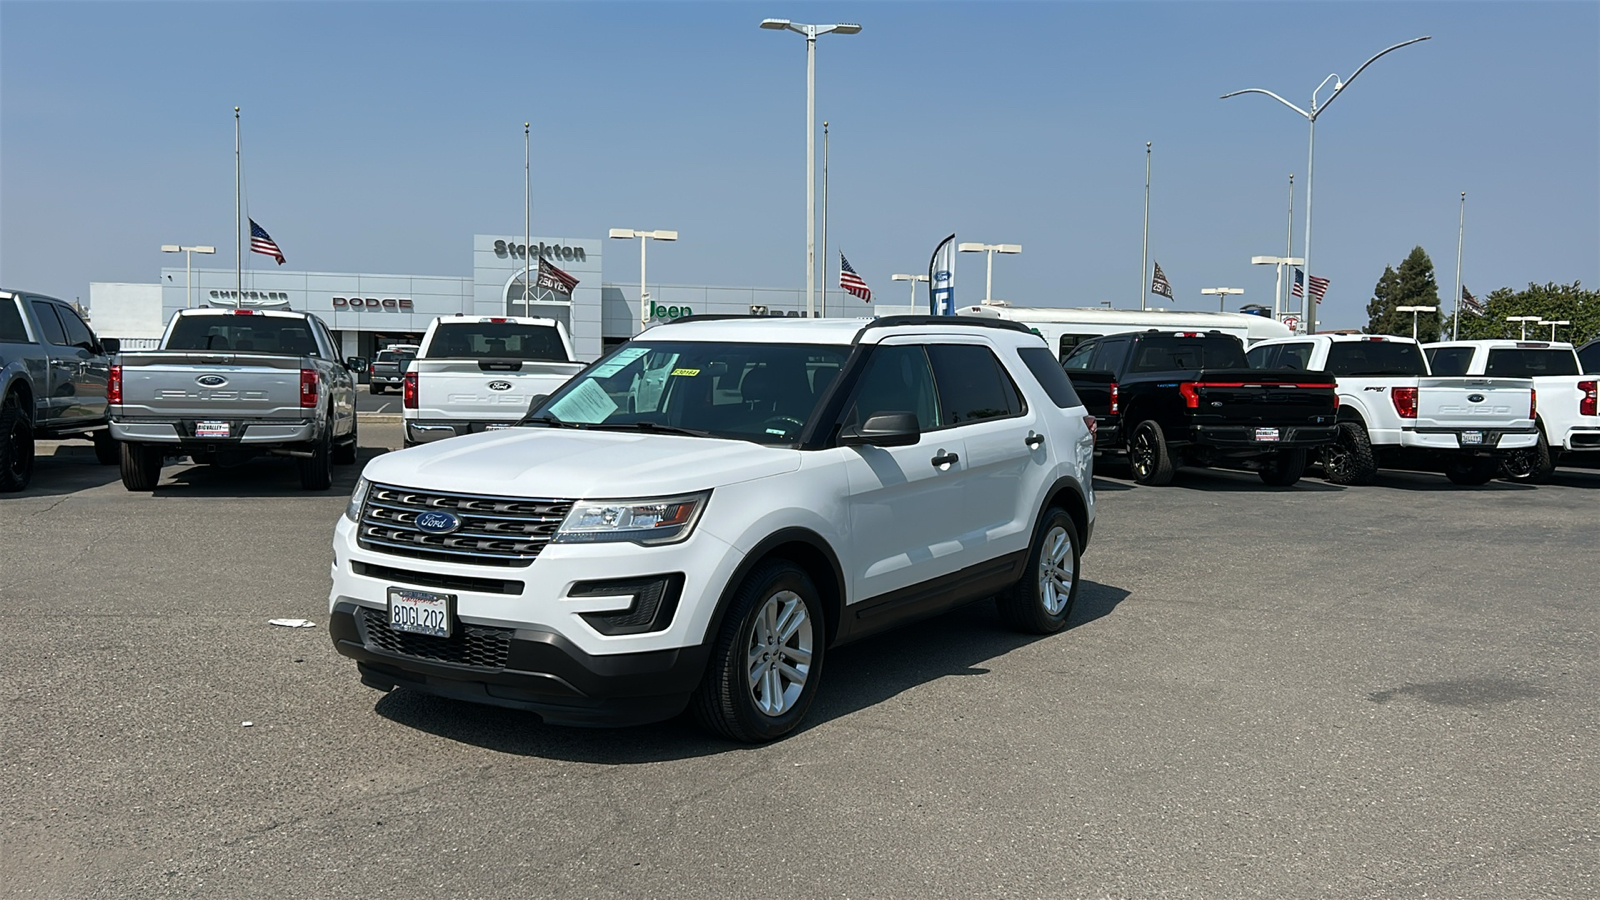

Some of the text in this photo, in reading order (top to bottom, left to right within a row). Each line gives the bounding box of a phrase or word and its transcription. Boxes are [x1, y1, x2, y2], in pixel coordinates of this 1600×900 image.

[494, 240, 586, 261] Stockton
[209, 290, 289, 300] CHRYSLER
[332, 297, 414, 311] DODGE
[1438, 405, 1512, 415] F-150
[421, 513, 447, 528] Ford
[394, 605, 445, 630] 8DGL202
